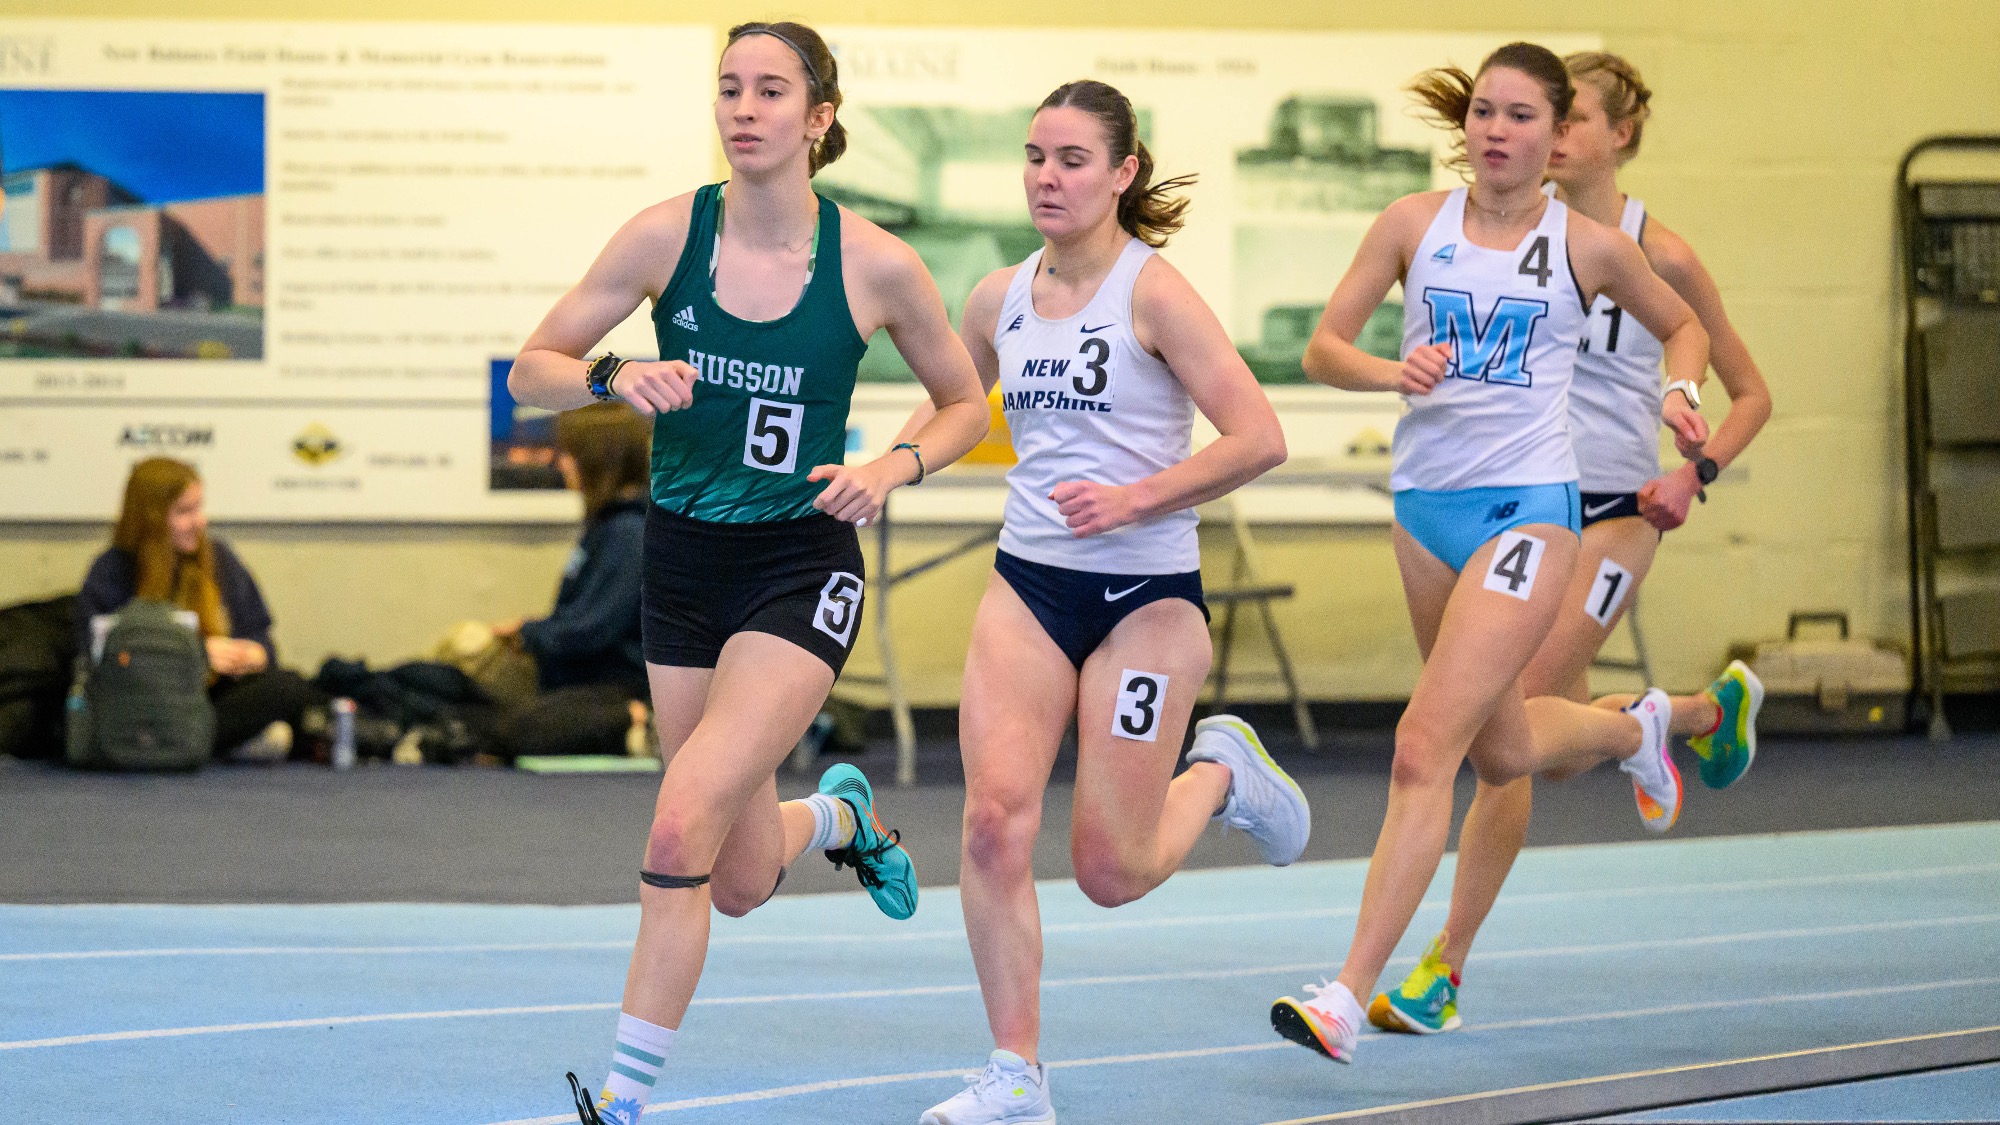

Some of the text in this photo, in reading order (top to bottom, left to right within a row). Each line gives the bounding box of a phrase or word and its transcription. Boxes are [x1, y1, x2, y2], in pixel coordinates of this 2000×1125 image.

[1518, 235, 1553, 288] 4
[671, 316, 699, 332] adidas
[1422, 286, 1549, 388] M
[1601, 305, 1622, 352] 1
[688, 348, 805, 396] HUSSON
[1021, 359, 1071, 377] NEW
[1072, 337, 1110, 397] 3
[750, 403, 793, 467] 5
[1493, 538, 1533, 592] 4
[822, 574, 859, 635] 5
[1597, 571, 1623, 619] 1
[1120, 676, 1158, 736] 3
